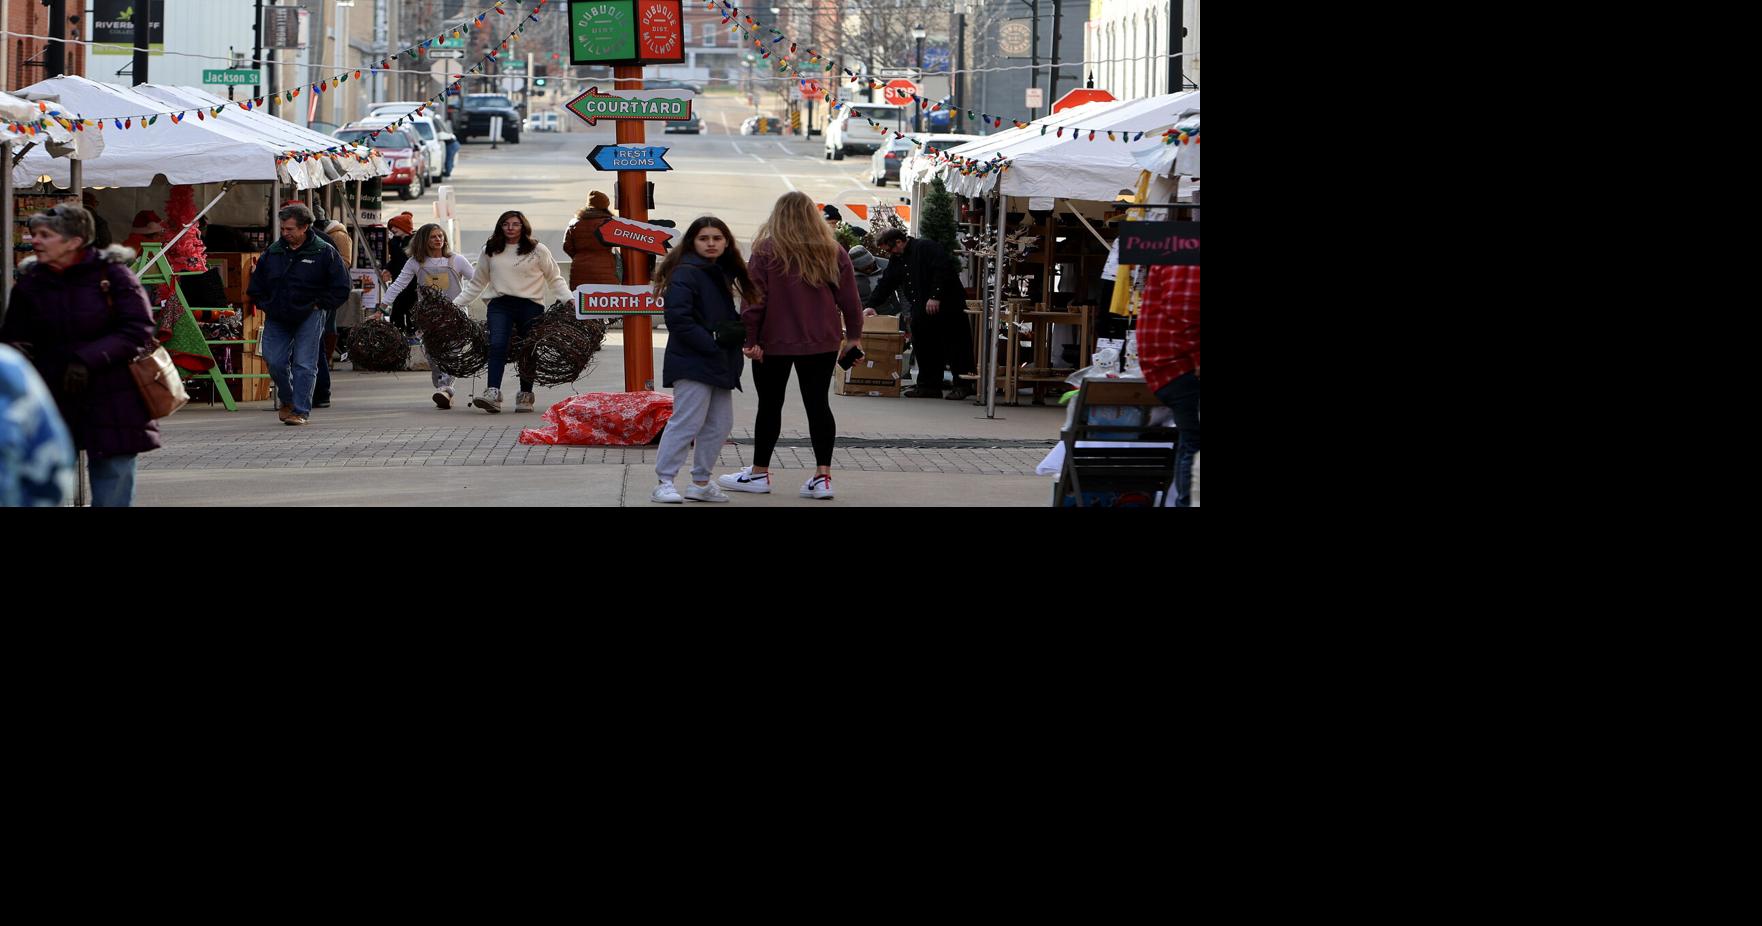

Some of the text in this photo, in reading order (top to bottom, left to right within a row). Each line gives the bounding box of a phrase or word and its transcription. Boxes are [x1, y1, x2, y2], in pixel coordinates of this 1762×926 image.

[643, 4, 677, 26] DUBUQUE
[643, 32, 677, 54] MILLWORK
[205, 71, 259, 83] Jackson St
[885, 87, 916, 98] STOP
[586, 100, 681, 114] COURTYARD
[620, 150, 647, 158] REST
[613, 158, 655, 166] ROOMS
[613, 228, 655, 244] DRINKS
[589, 296, 665, 308] NORTH PO
